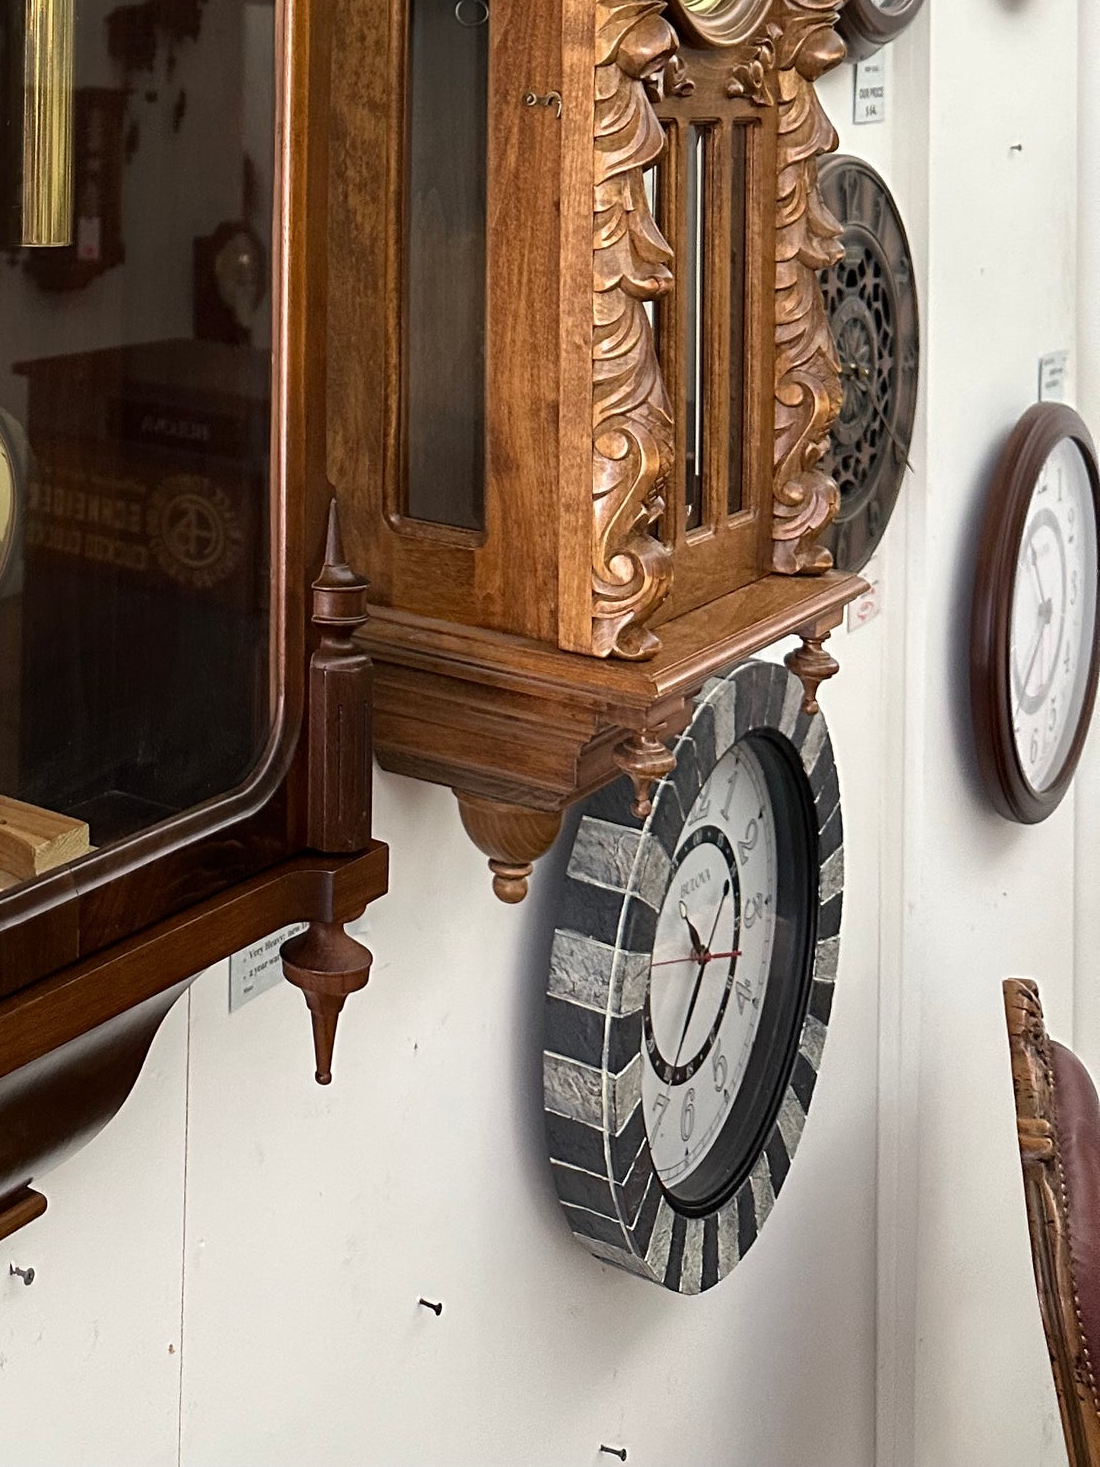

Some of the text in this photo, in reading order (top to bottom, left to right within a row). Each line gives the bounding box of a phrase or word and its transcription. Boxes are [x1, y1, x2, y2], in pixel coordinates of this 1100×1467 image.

[720, 770, 738, 821] 1
[737, 818, 759, 866] 2
[712, 1038, 728, 1092] 5
[680, 1087, 695, 1142] 6
